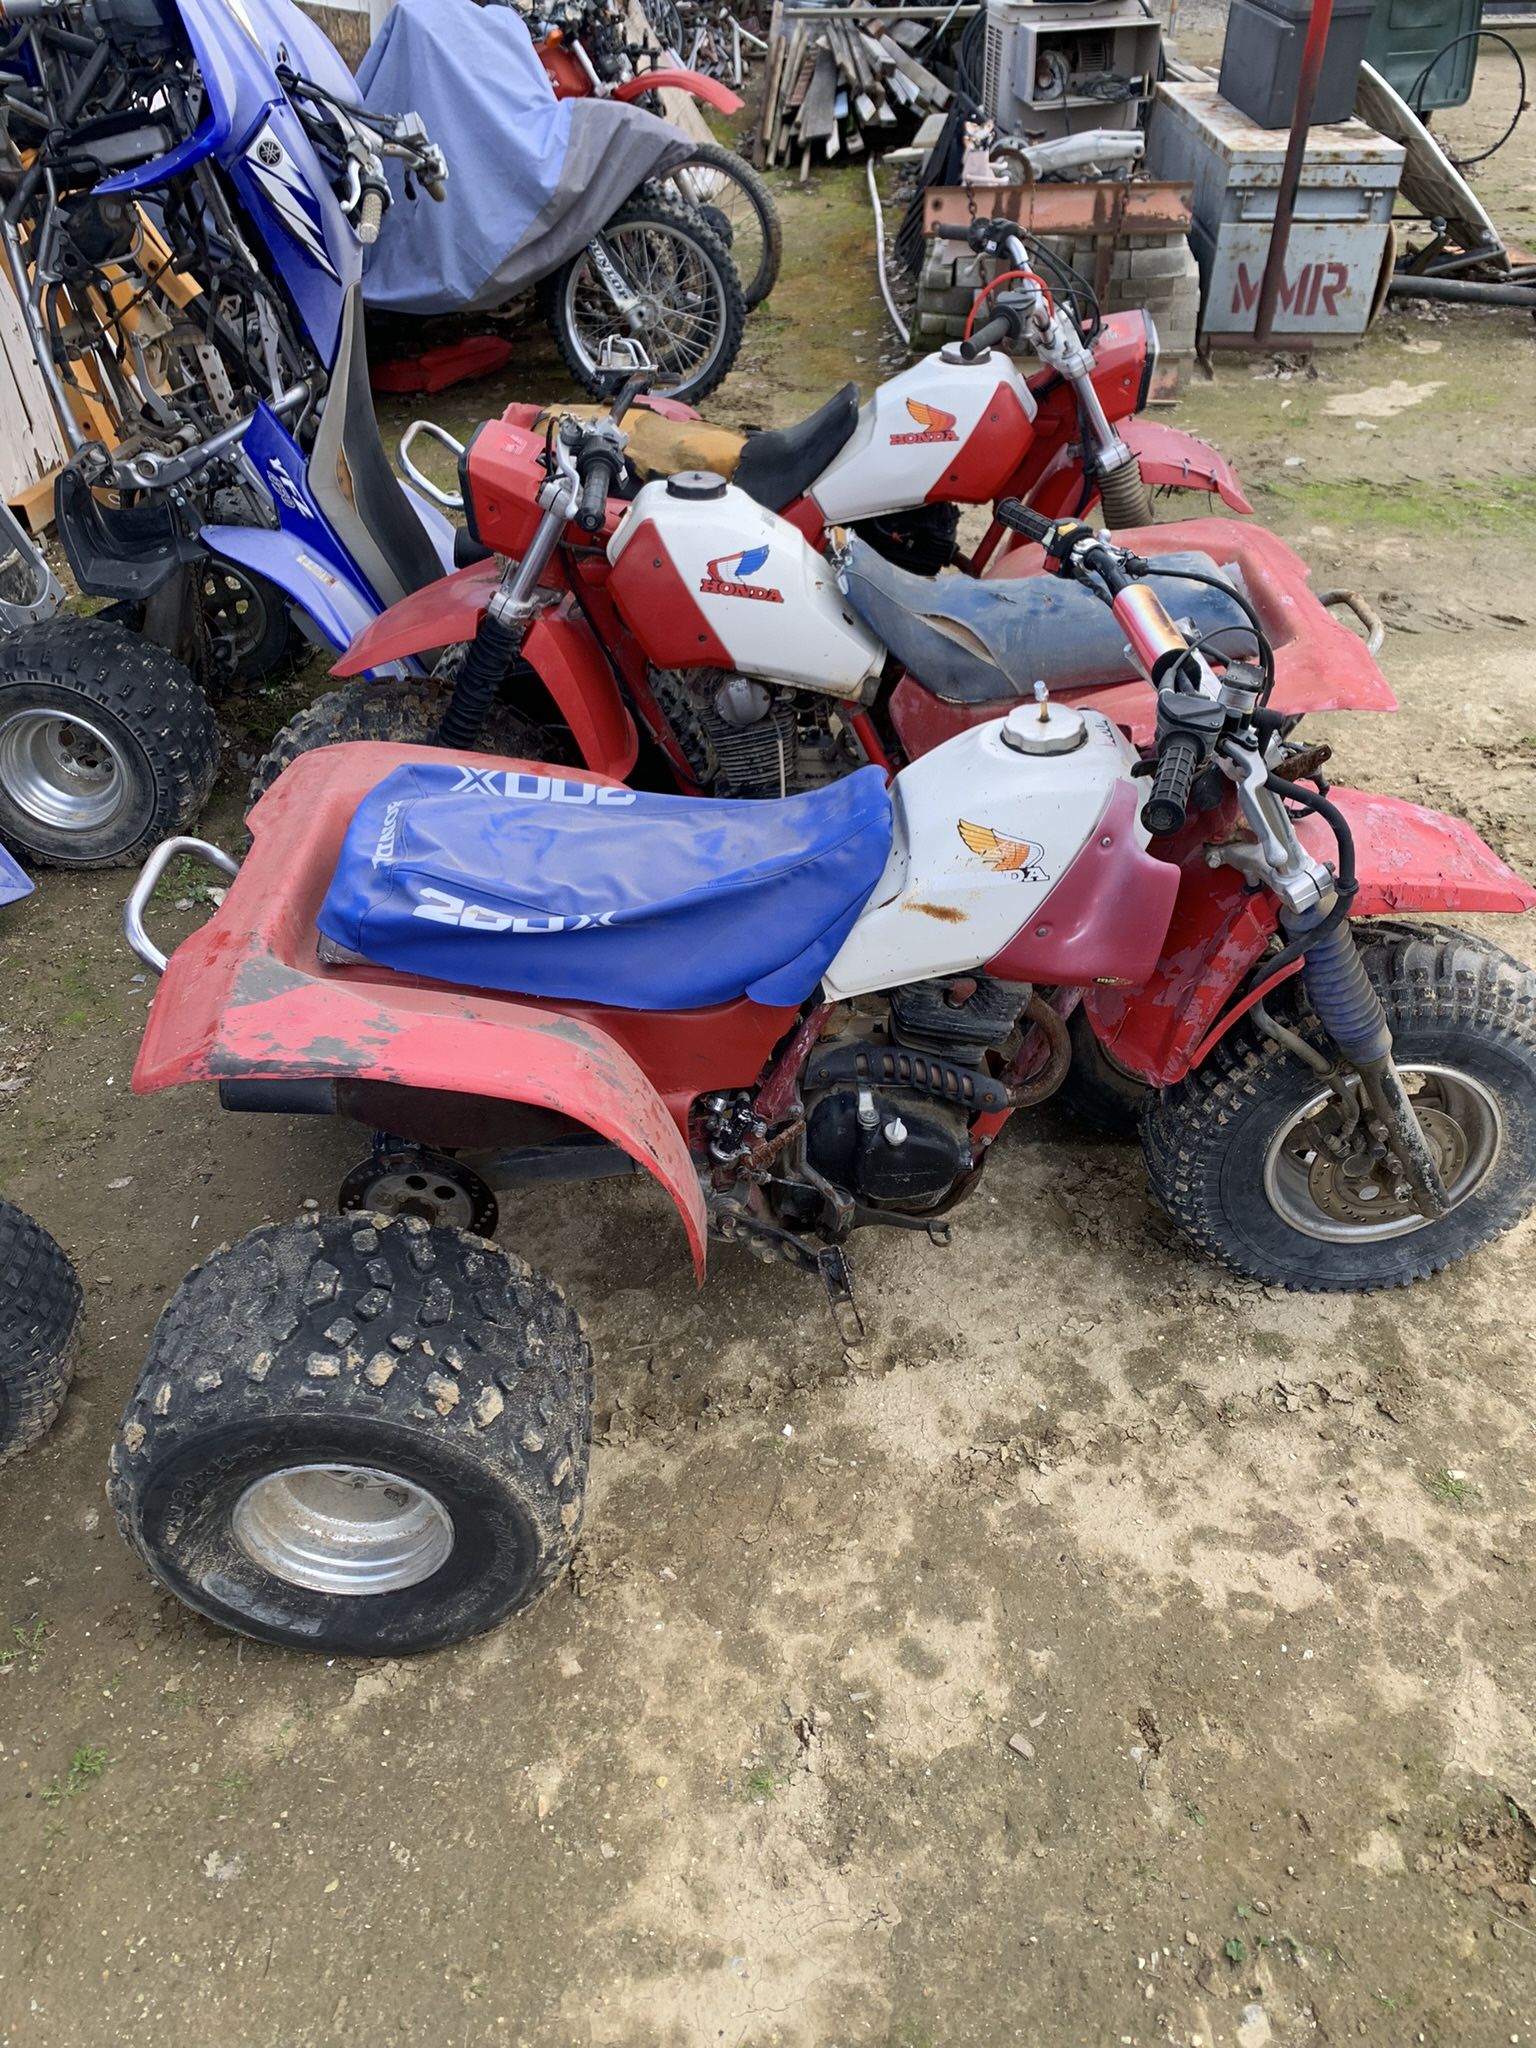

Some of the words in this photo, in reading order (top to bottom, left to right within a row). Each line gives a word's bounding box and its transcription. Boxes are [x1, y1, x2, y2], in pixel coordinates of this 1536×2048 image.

[889, 430, 960, 446] HONDA
[268, 457, 315, 520] YFZ
[699, 577, 785, 604] HONDA
[412, 887, 619, 933] 200X
